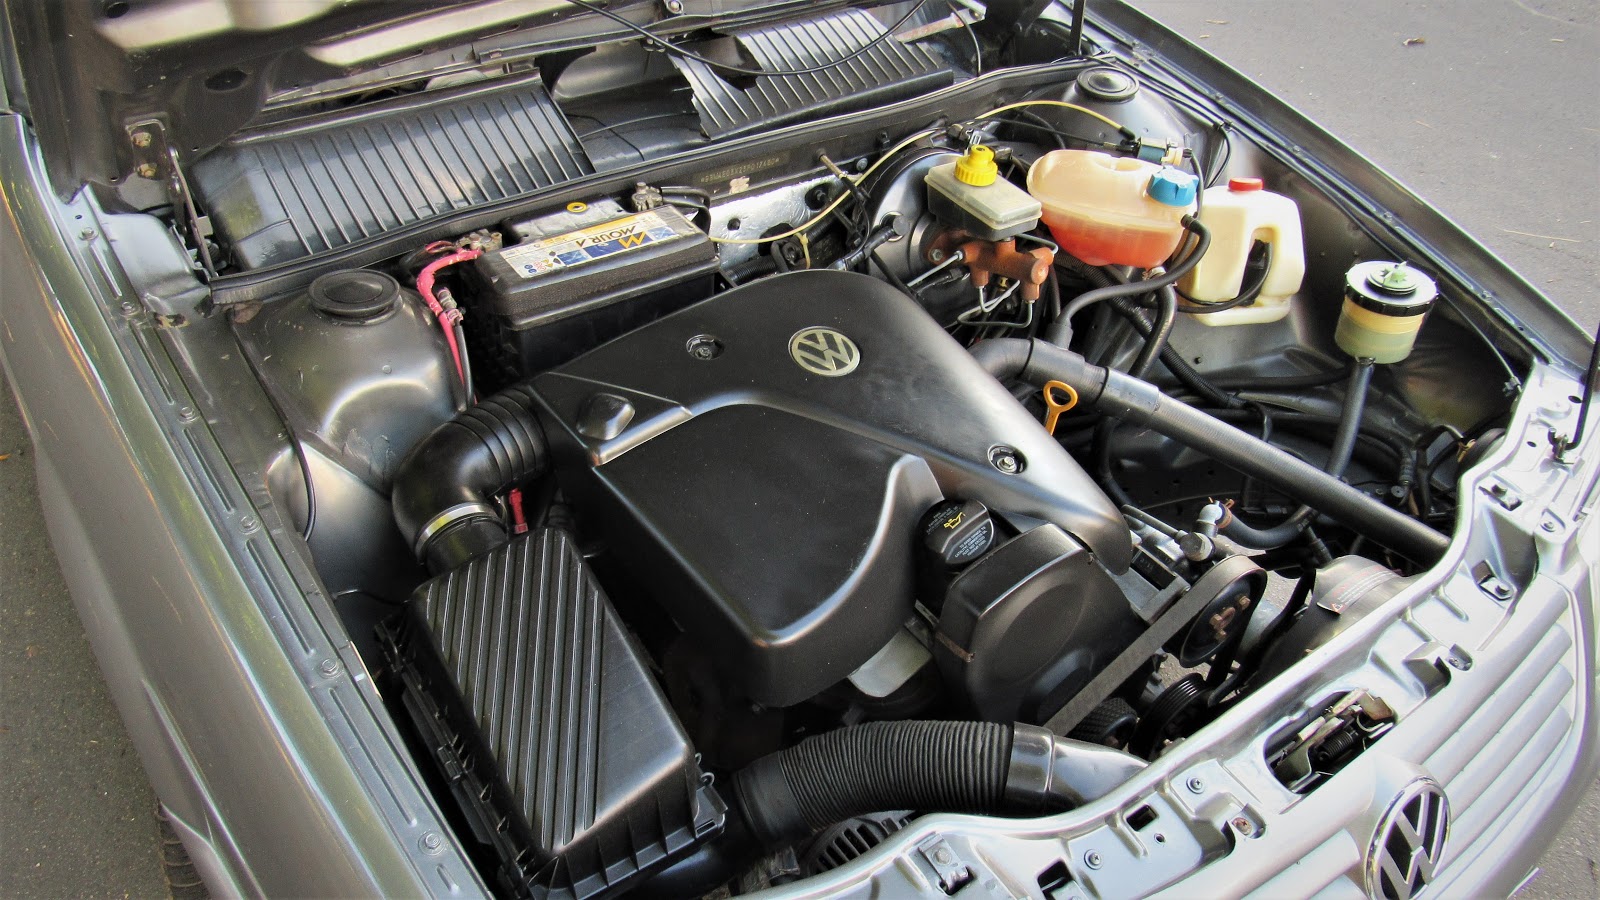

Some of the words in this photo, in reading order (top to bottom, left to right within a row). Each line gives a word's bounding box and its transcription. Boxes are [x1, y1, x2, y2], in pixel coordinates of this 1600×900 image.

[576, 225, 636, 247] MOURA
[788, 326, 861, 377] VW
[1366, 777, 1451, 900] VW
